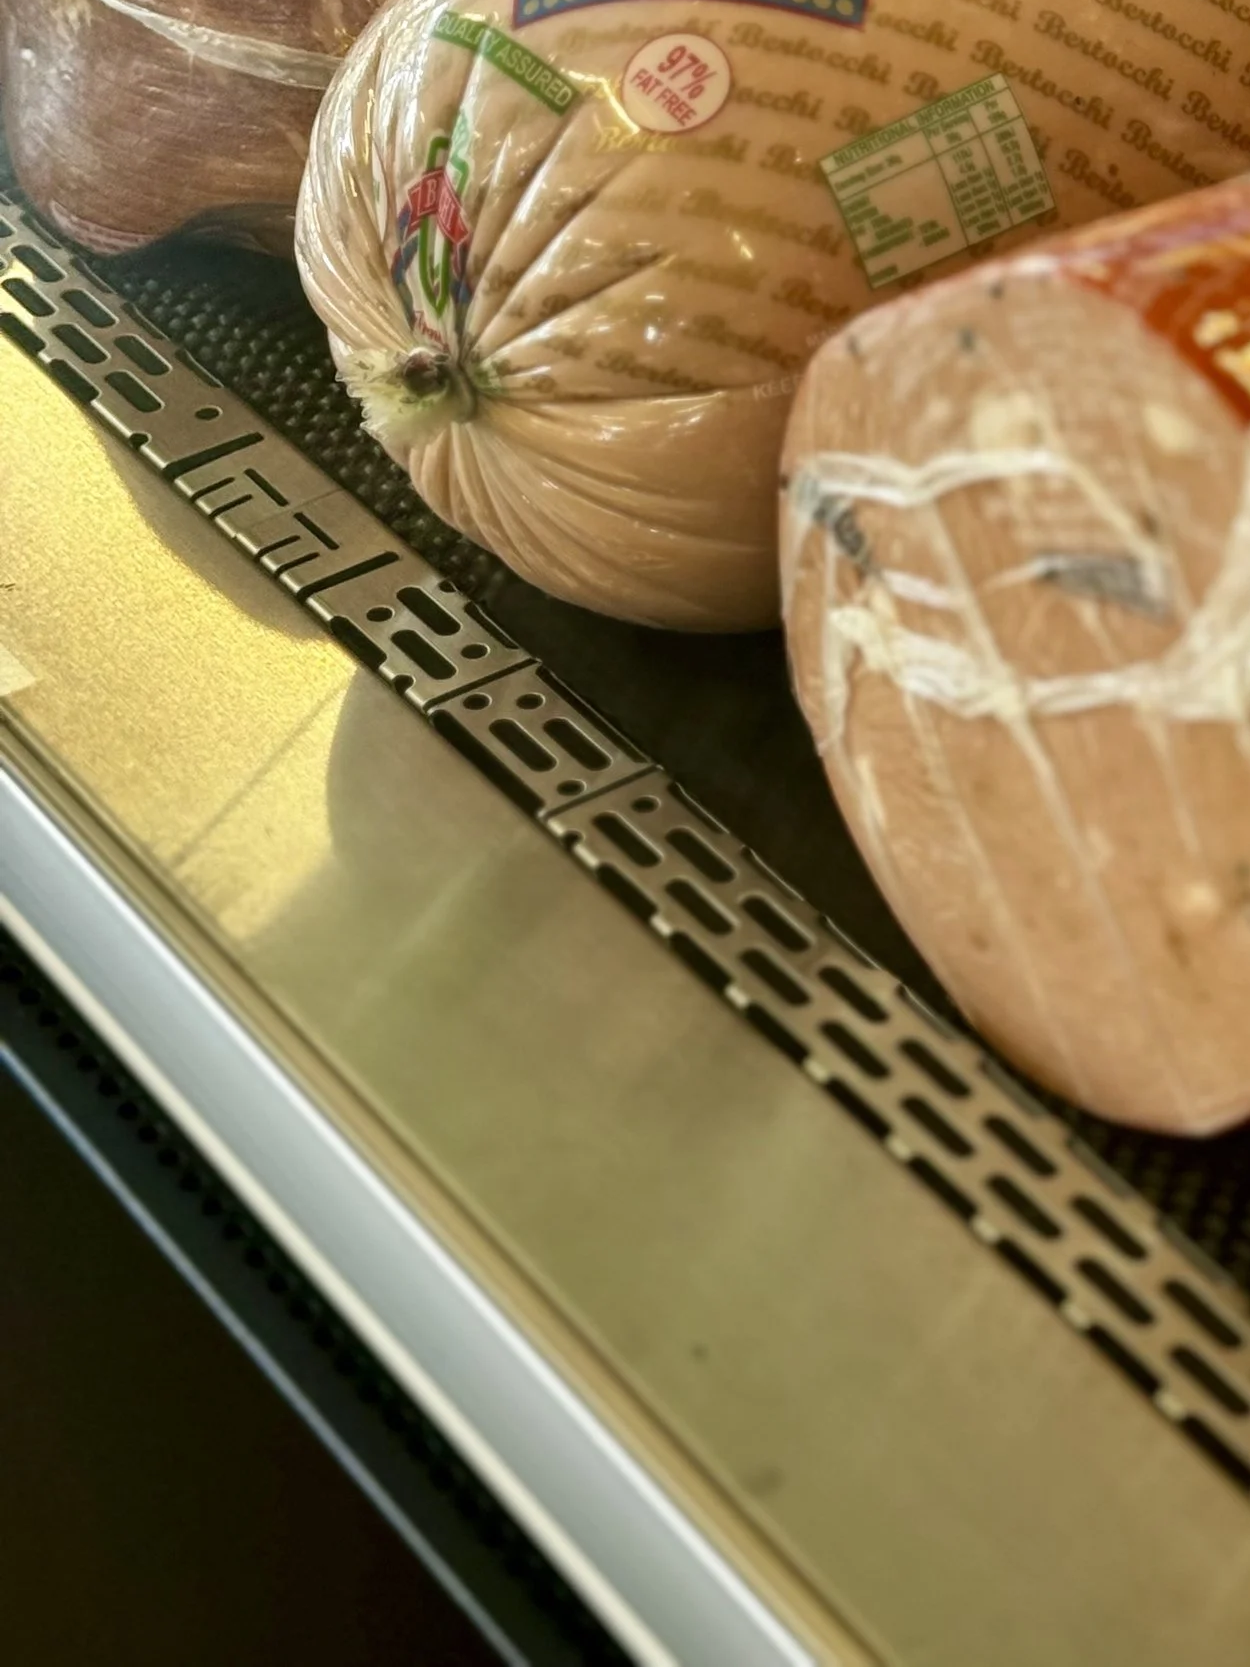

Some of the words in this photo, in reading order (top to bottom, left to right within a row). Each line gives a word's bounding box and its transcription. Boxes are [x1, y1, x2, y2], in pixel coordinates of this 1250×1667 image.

[434, 12, 501, 52] QUALITY
[495, 43, 575, 108] ASSURED
[657, 45, 718, 101] 97%
[729, 20, 893, 87] Bertocchi
[873, 11, 960, 53] occhi
[969, 39, 1115, 131] Bertocchi
[1033, 9, 1177, 102] Bertocchi
[629, 67, 659, 97] FAT
[653, 89, 698, 127] FREE
[734, 85, 826, 122] occhi
[832, 118, 918, 166] NUTRITIONAL
[915, 79, 996, 125] INFORMATION
